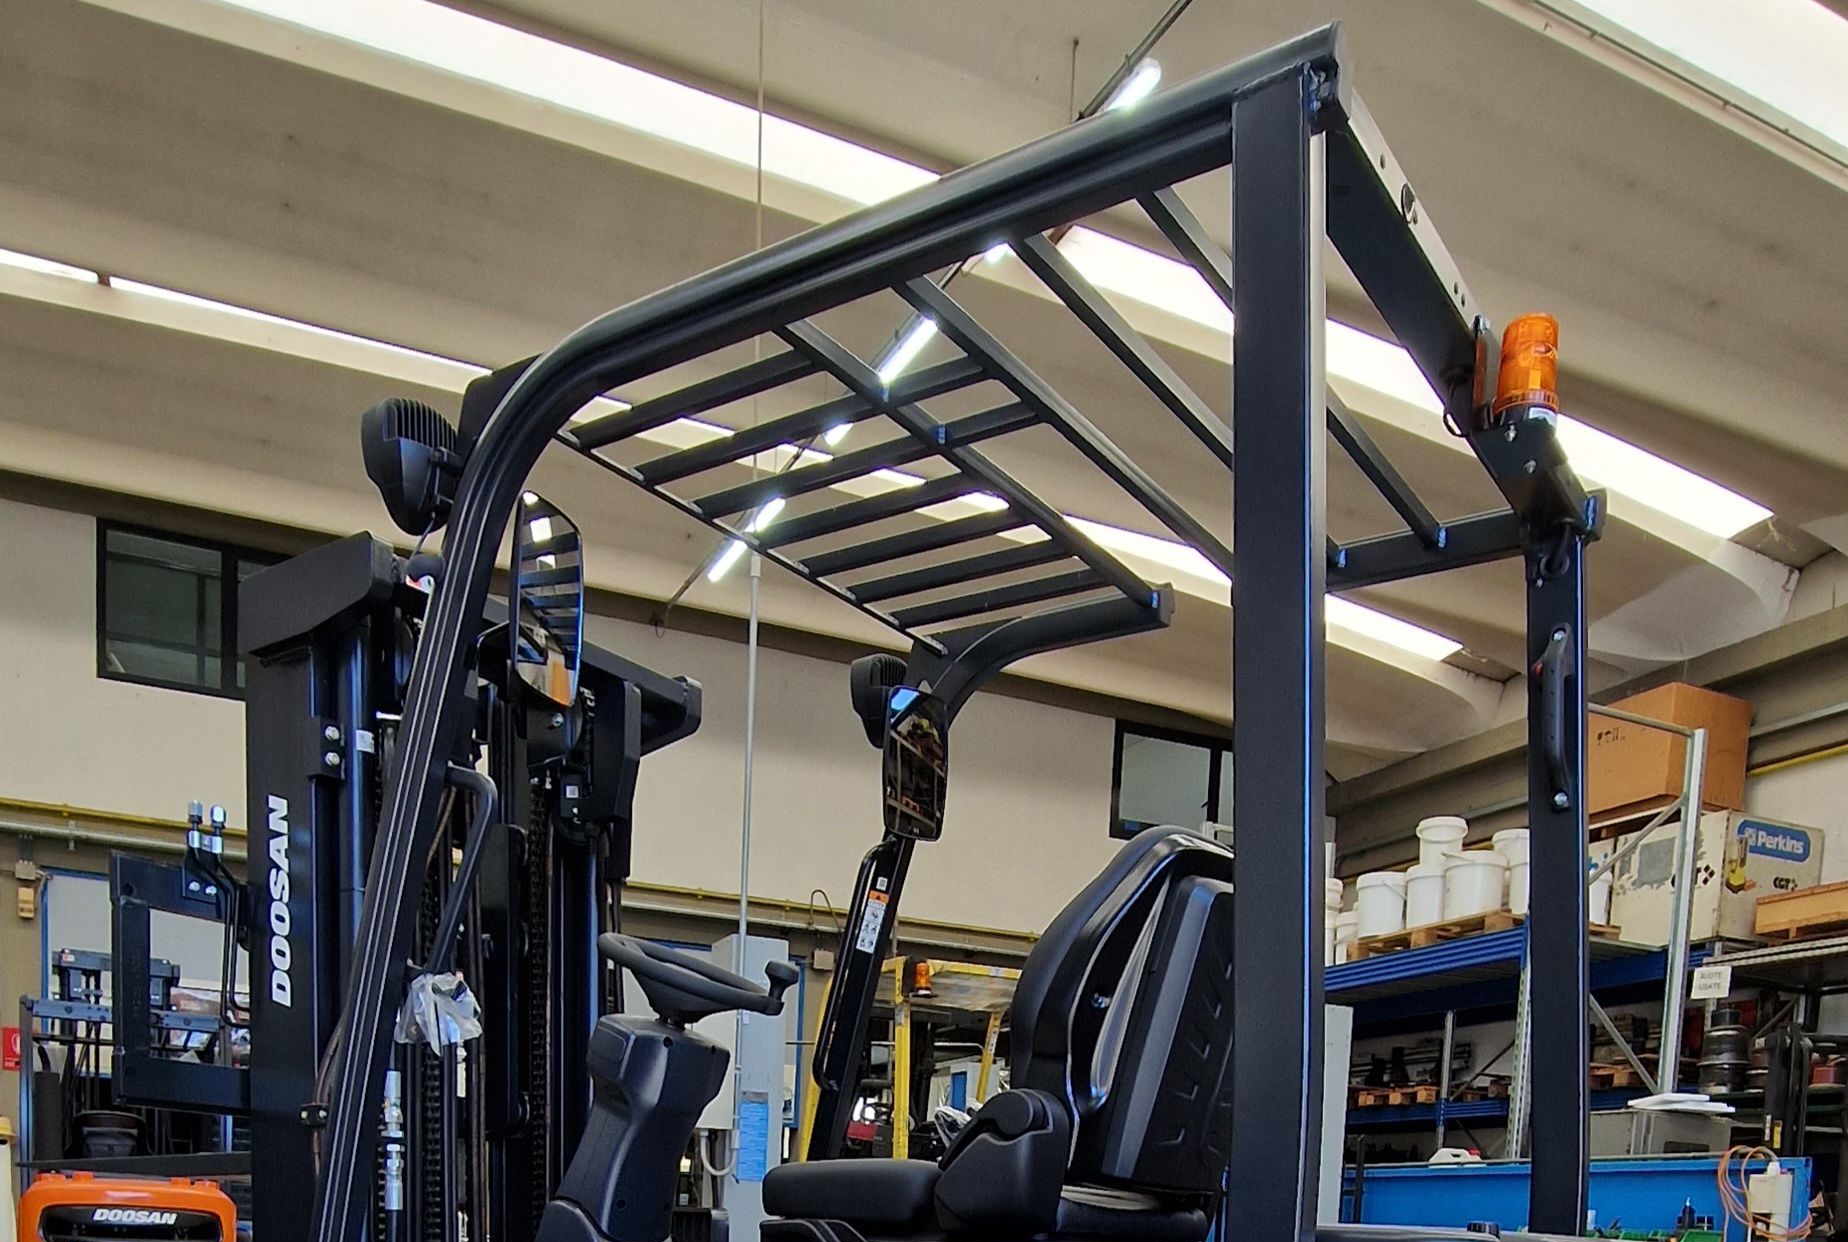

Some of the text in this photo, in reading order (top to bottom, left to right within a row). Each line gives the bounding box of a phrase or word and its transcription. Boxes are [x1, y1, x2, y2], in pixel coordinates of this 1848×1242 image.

[1757, 830, 1804, 854] Perkins
[267, 794, 292, 1008] DOOSAN
[93, 1208, 178, 1225] DOOSAN
